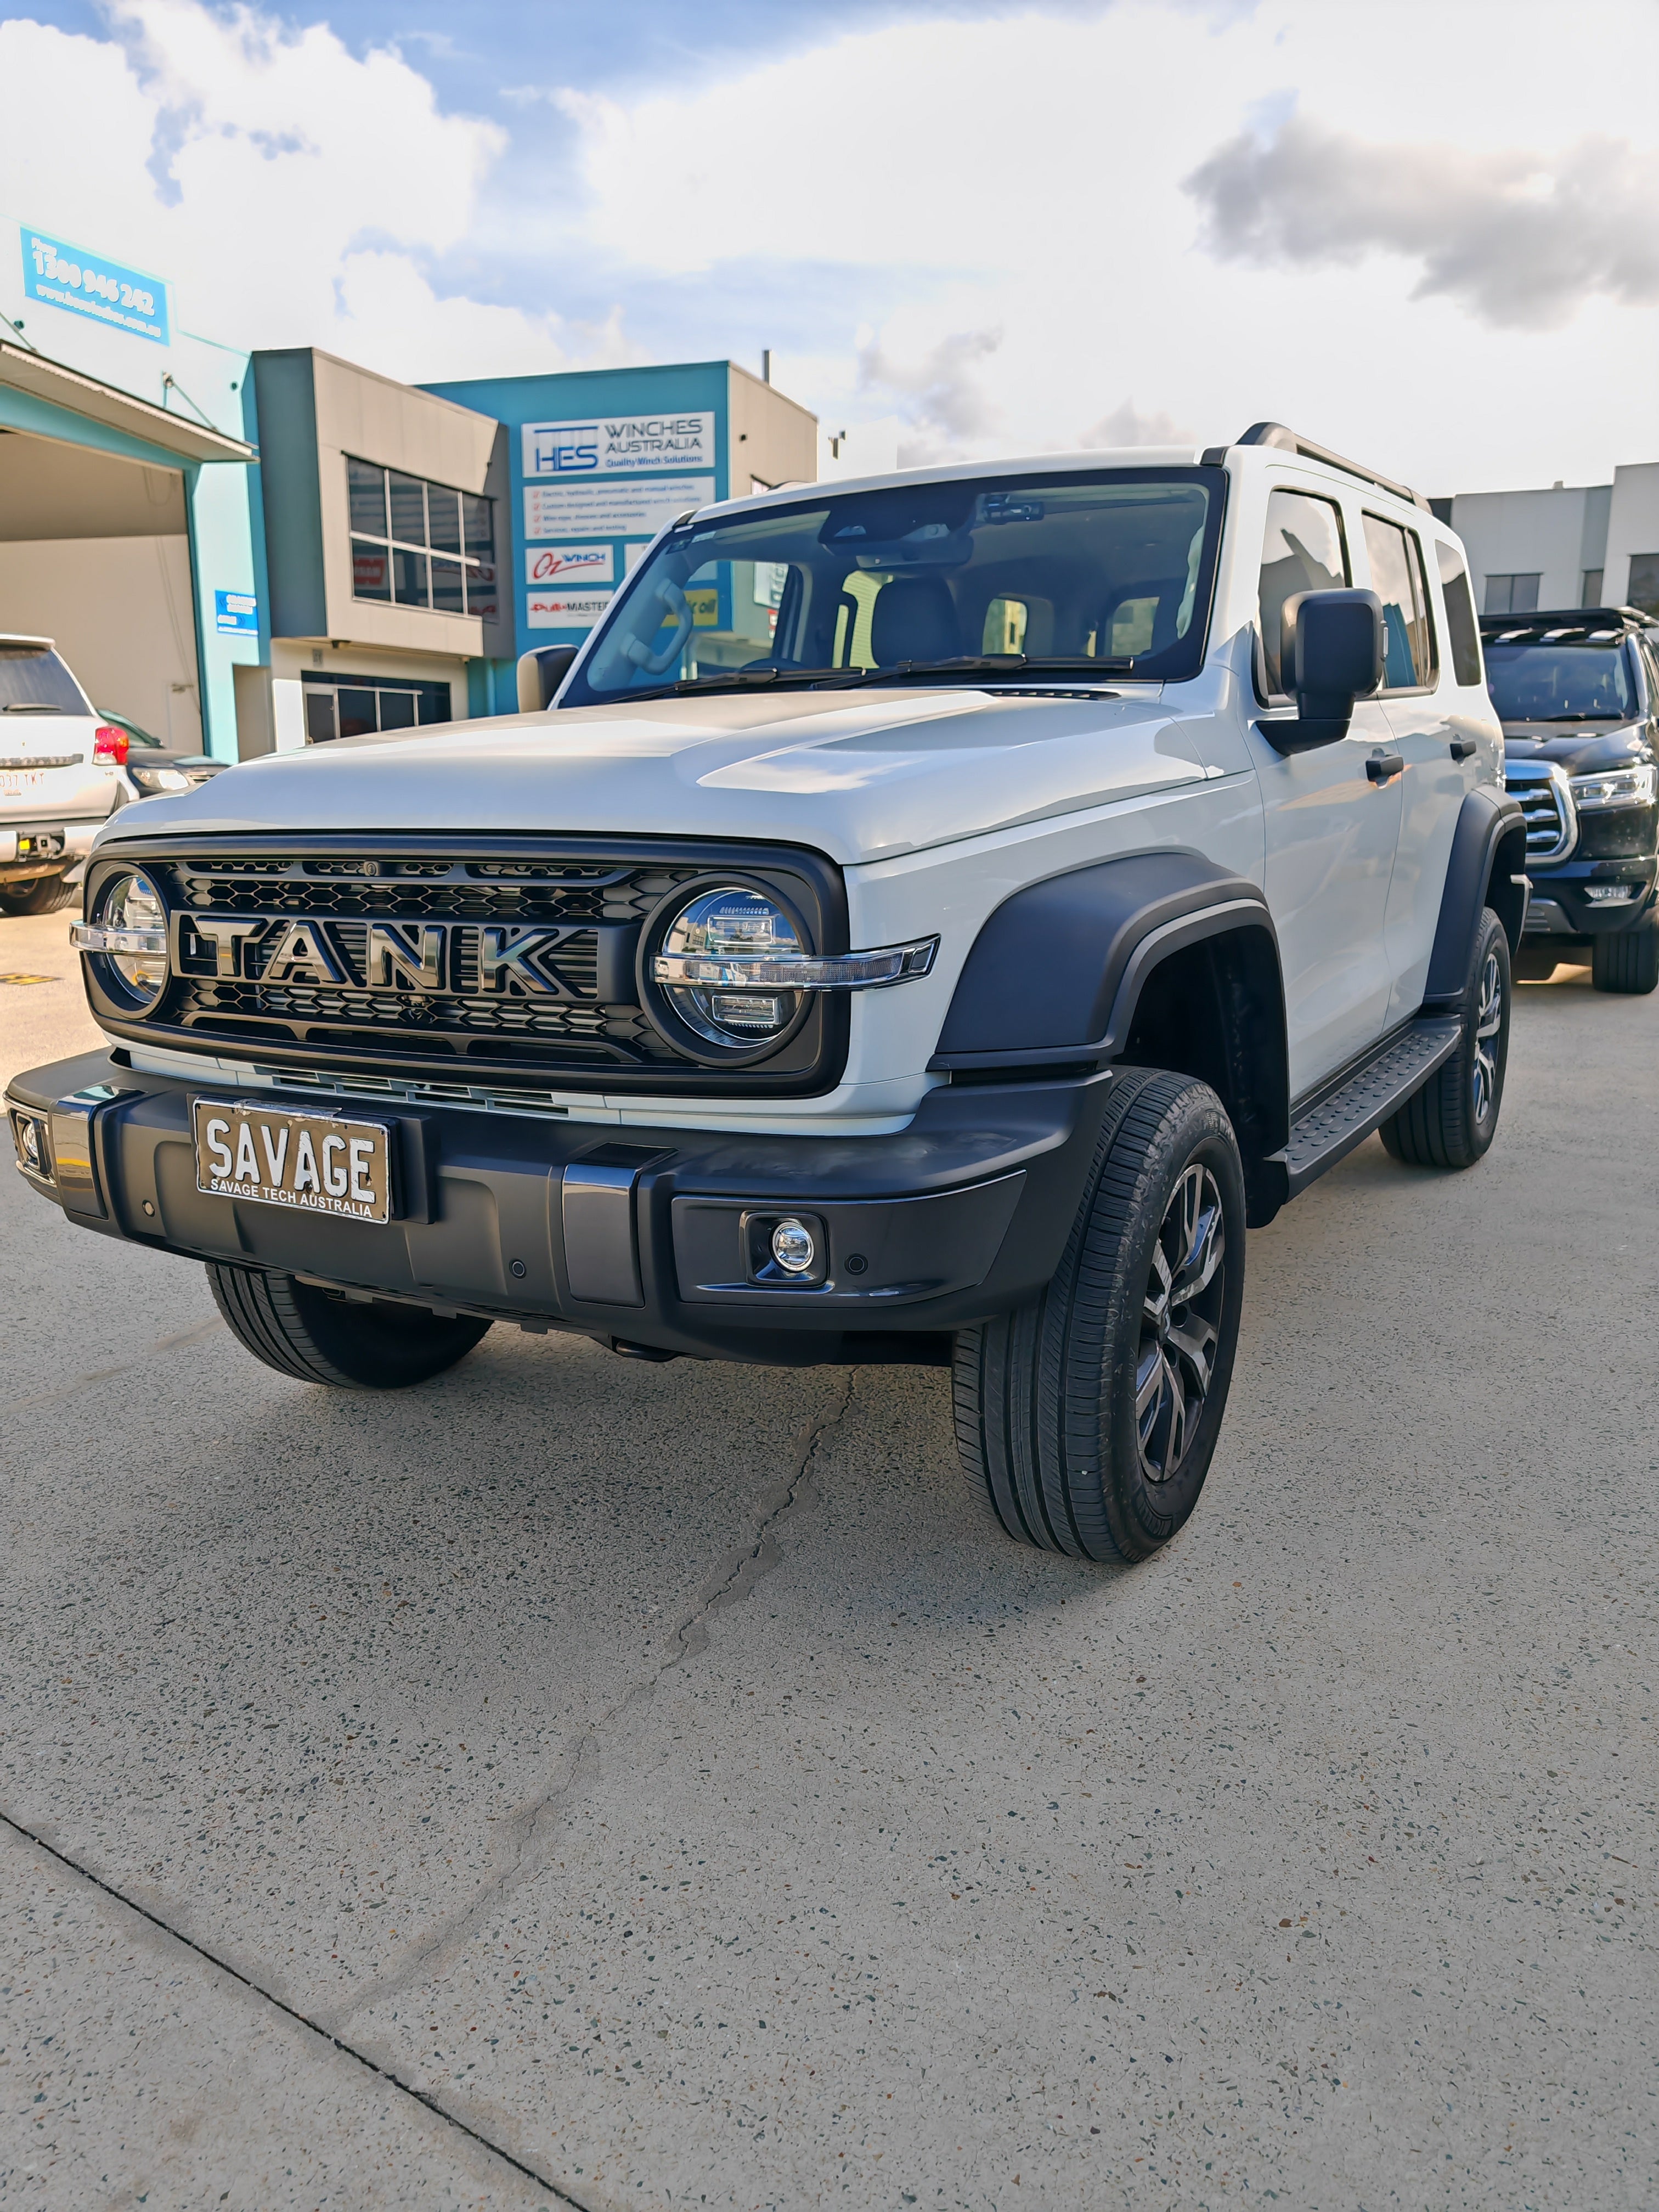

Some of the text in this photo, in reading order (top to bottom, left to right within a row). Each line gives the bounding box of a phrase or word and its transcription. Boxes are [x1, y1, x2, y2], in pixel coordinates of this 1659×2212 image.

[32, 251, 155, 316] 1300 946 242
[605, 419, 703, 438] WINCHES
[536, 444, 599, 472] HES
[605, 438, 703, 454] AUSTRALIA
[605, 455, 703, 469] Quality Winch Solutions
[562, 552, 606, 563] WINCH
[194, 916, 559, 994] TANK
[206, 1118, 376, 1204] SAVAGE
[211, 1178, 373, 1218] SAVAGE TECH AUSTRALIA
